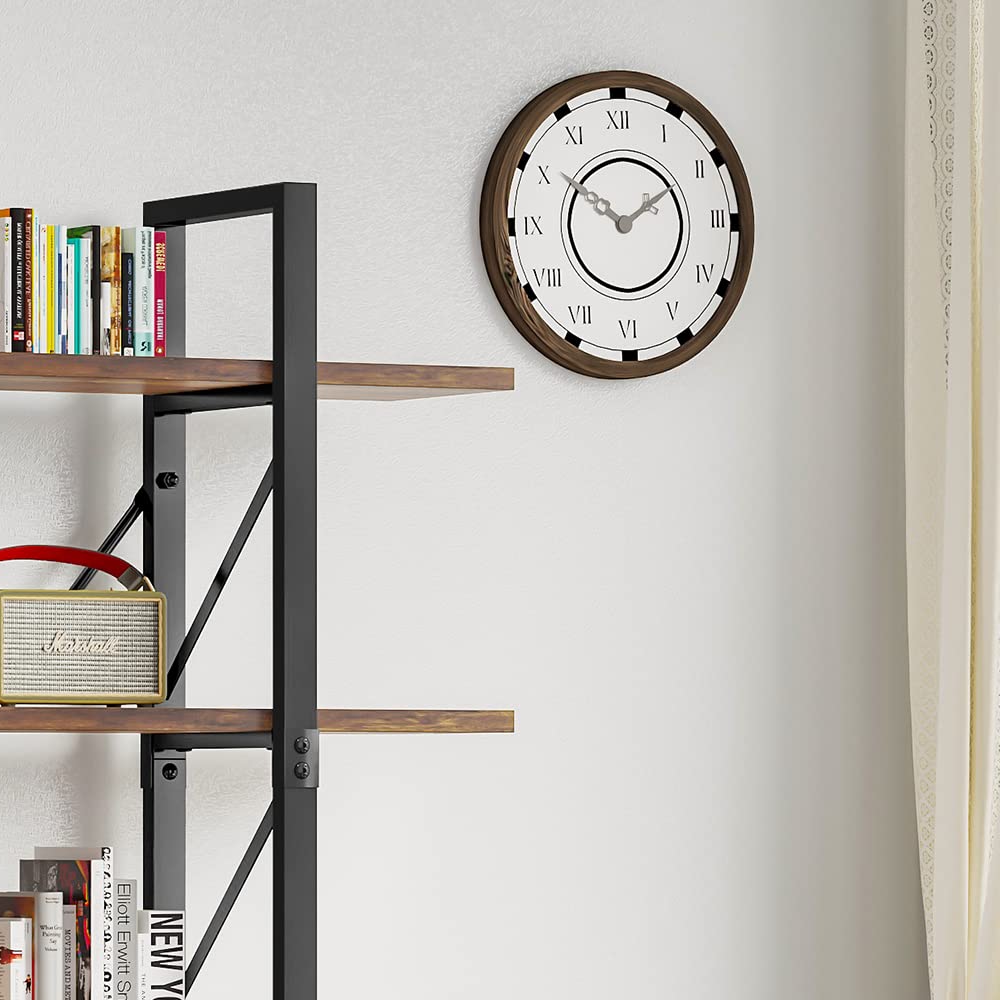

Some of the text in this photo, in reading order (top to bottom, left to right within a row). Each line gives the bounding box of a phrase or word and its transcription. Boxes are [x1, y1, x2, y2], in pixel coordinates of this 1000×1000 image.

[606, 110, 630, 130] XII
[565, 126, 583, 145] XI
[661, 124, 667, 143] I
[538, 165, 551, 185] X
[695, 159, 705, 179] II
[524, 216, 543, 236] IX
[711, 209, 725, 228] III
[533, 268, 562, 288] VIII
[696, 263, 714, 283] IV
[567, 305, 592, 325] VII
[666, 301, 679, 321] V
[618, 319, 637, 339] VI
[42, 630, 120, 655] Marshall
[117, 883, 131, 926] Elliott
[150, 913, 183, 971] NEW
[117, 931, 131, 976] Erwitt
